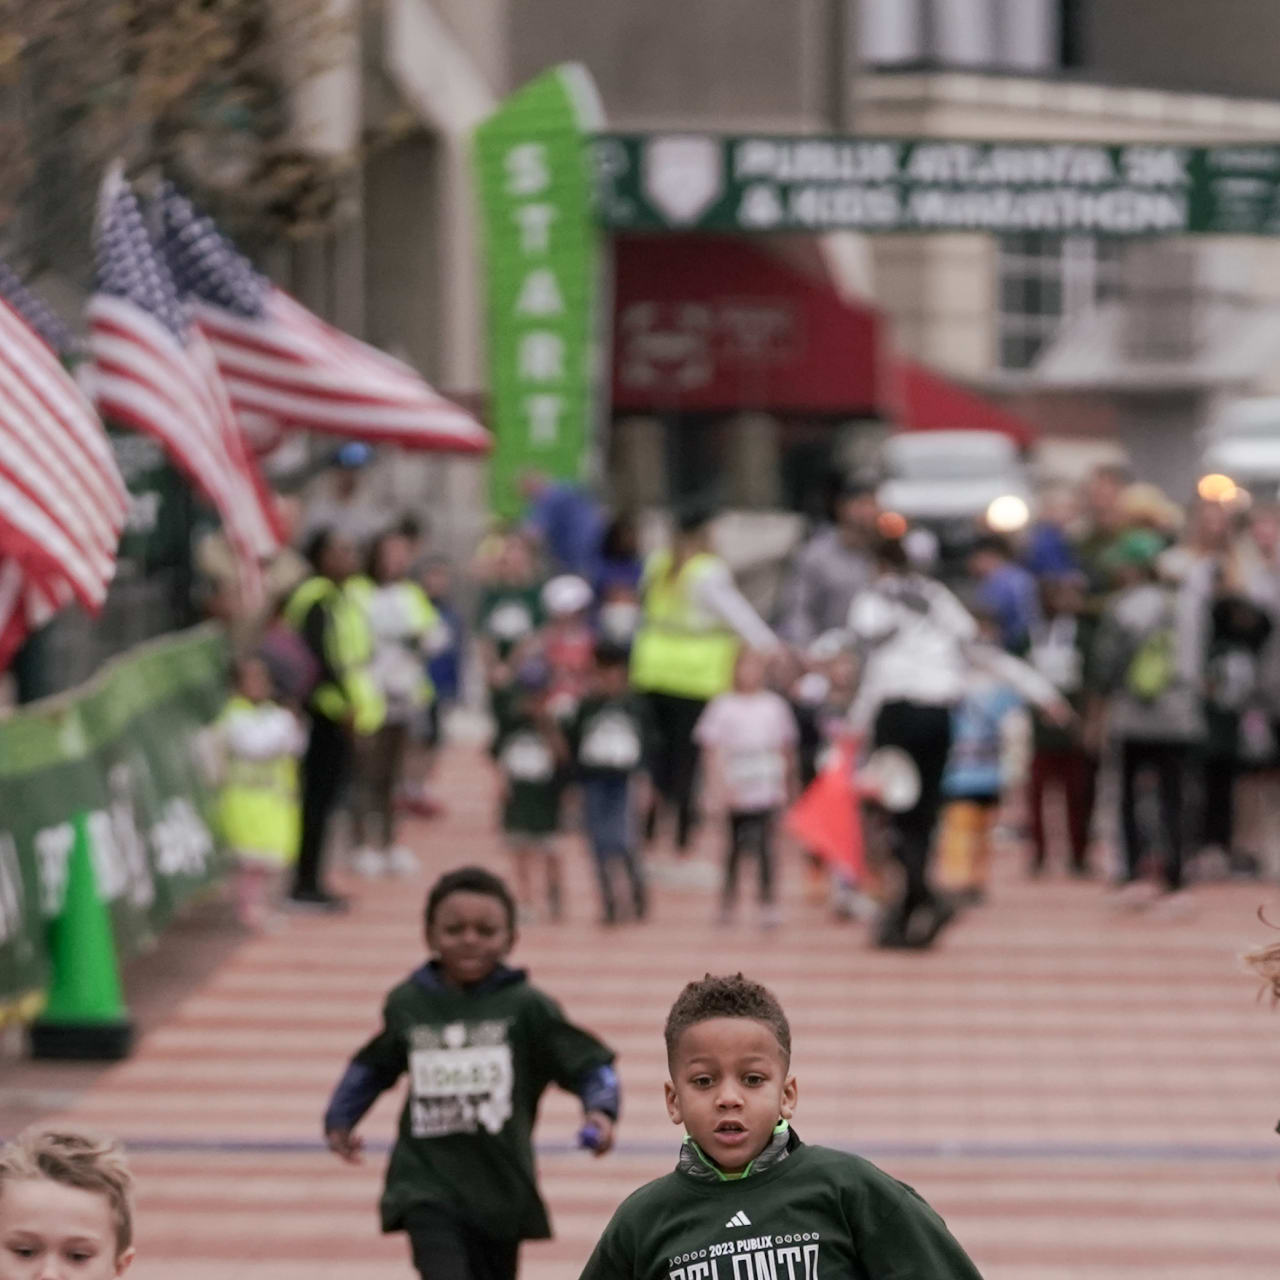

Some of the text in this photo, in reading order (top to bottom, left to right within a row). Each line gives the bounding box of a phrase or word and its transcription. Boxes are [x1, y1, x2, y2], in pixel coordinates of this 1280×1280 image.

[904, 146, 1115, 185] ATLANTA
[908, 188, 1188, 230] MARATHON
[502, 142, 564, 448] START
[709, 1235, 773, 1258] 2023 PUBLIX
